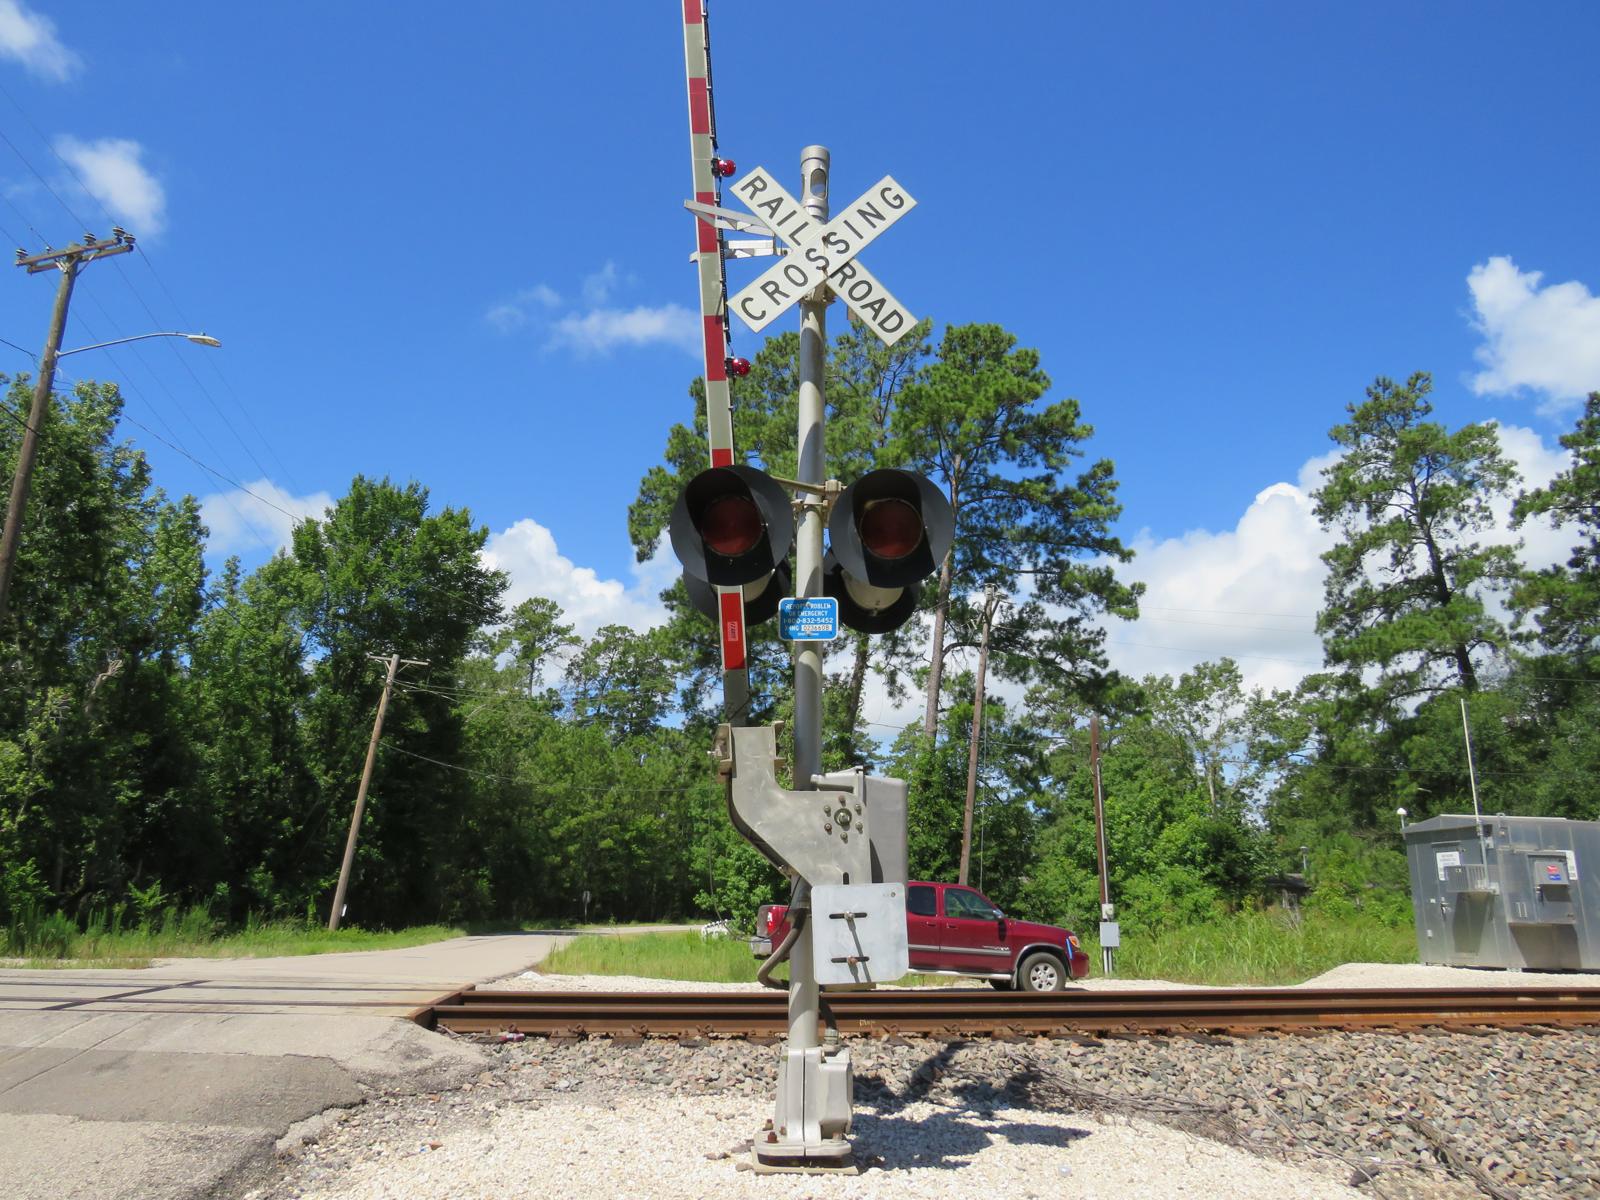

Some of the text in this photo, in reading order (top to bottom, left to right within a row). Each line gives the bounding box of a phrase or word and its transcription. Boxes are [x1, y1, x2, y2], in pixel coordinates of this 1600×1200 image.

[740, 186, 905, 321] CROSSING
[740, 175, 904, 334] RAIL ROAD
